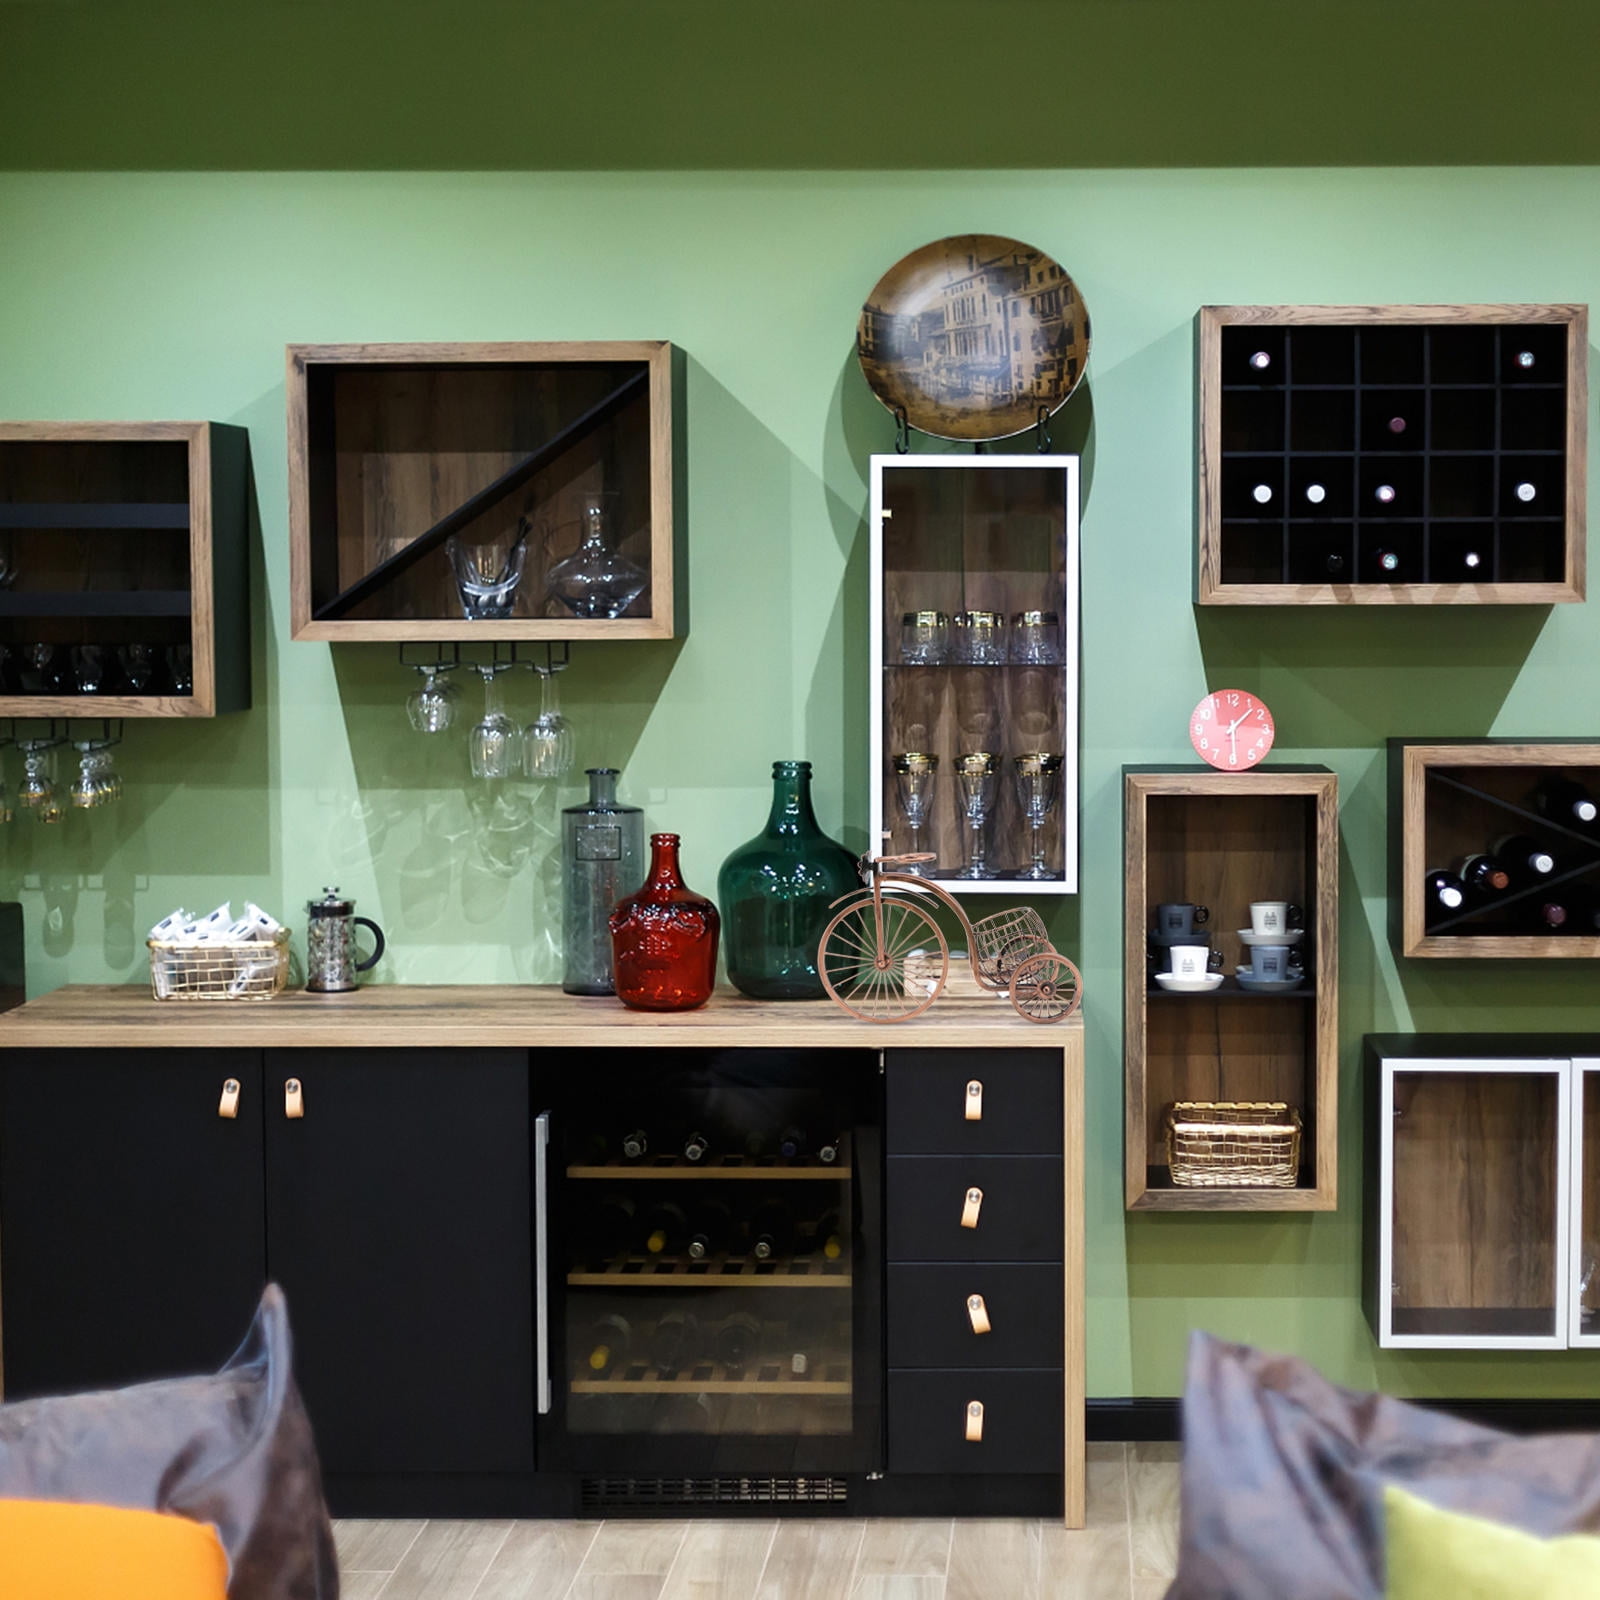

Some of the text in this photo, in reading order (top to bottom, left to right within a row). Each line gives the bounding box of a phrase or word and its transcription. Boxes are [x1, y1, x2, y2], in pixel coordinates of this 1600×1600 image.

[1256, 709, 1264, 720] 2
[1195, 724, 1203, 735] 9
[1262, 724, 1270, 735] 3
[1200, 738, 1208, 749] 8
[1256, 738, 1264, 748] 4
[1212, 749, 1219, 760] 7
[1248, 749, 1256, 760] 5
